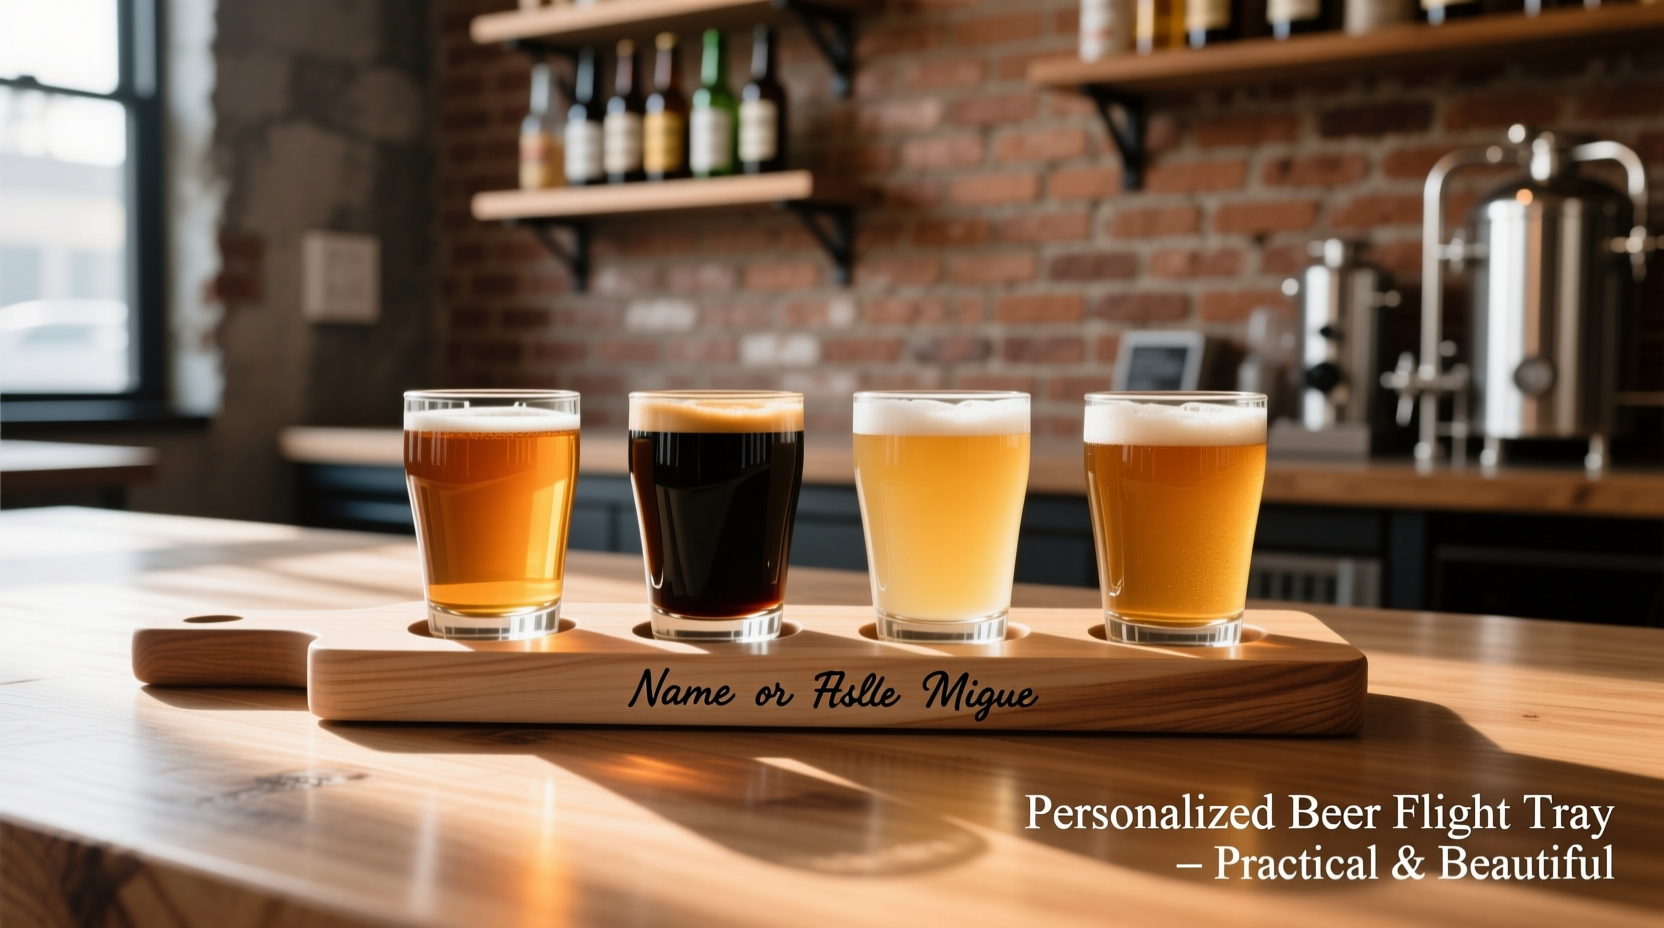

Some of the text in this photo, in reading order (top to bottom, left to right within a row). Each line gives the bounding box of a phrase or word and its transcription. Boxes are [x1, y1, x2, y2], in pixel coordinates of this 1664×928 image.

[628, 667, 736, 708] Name
[755, 682, 795, 707] or
[922, 670, 1039, 722] Migue
